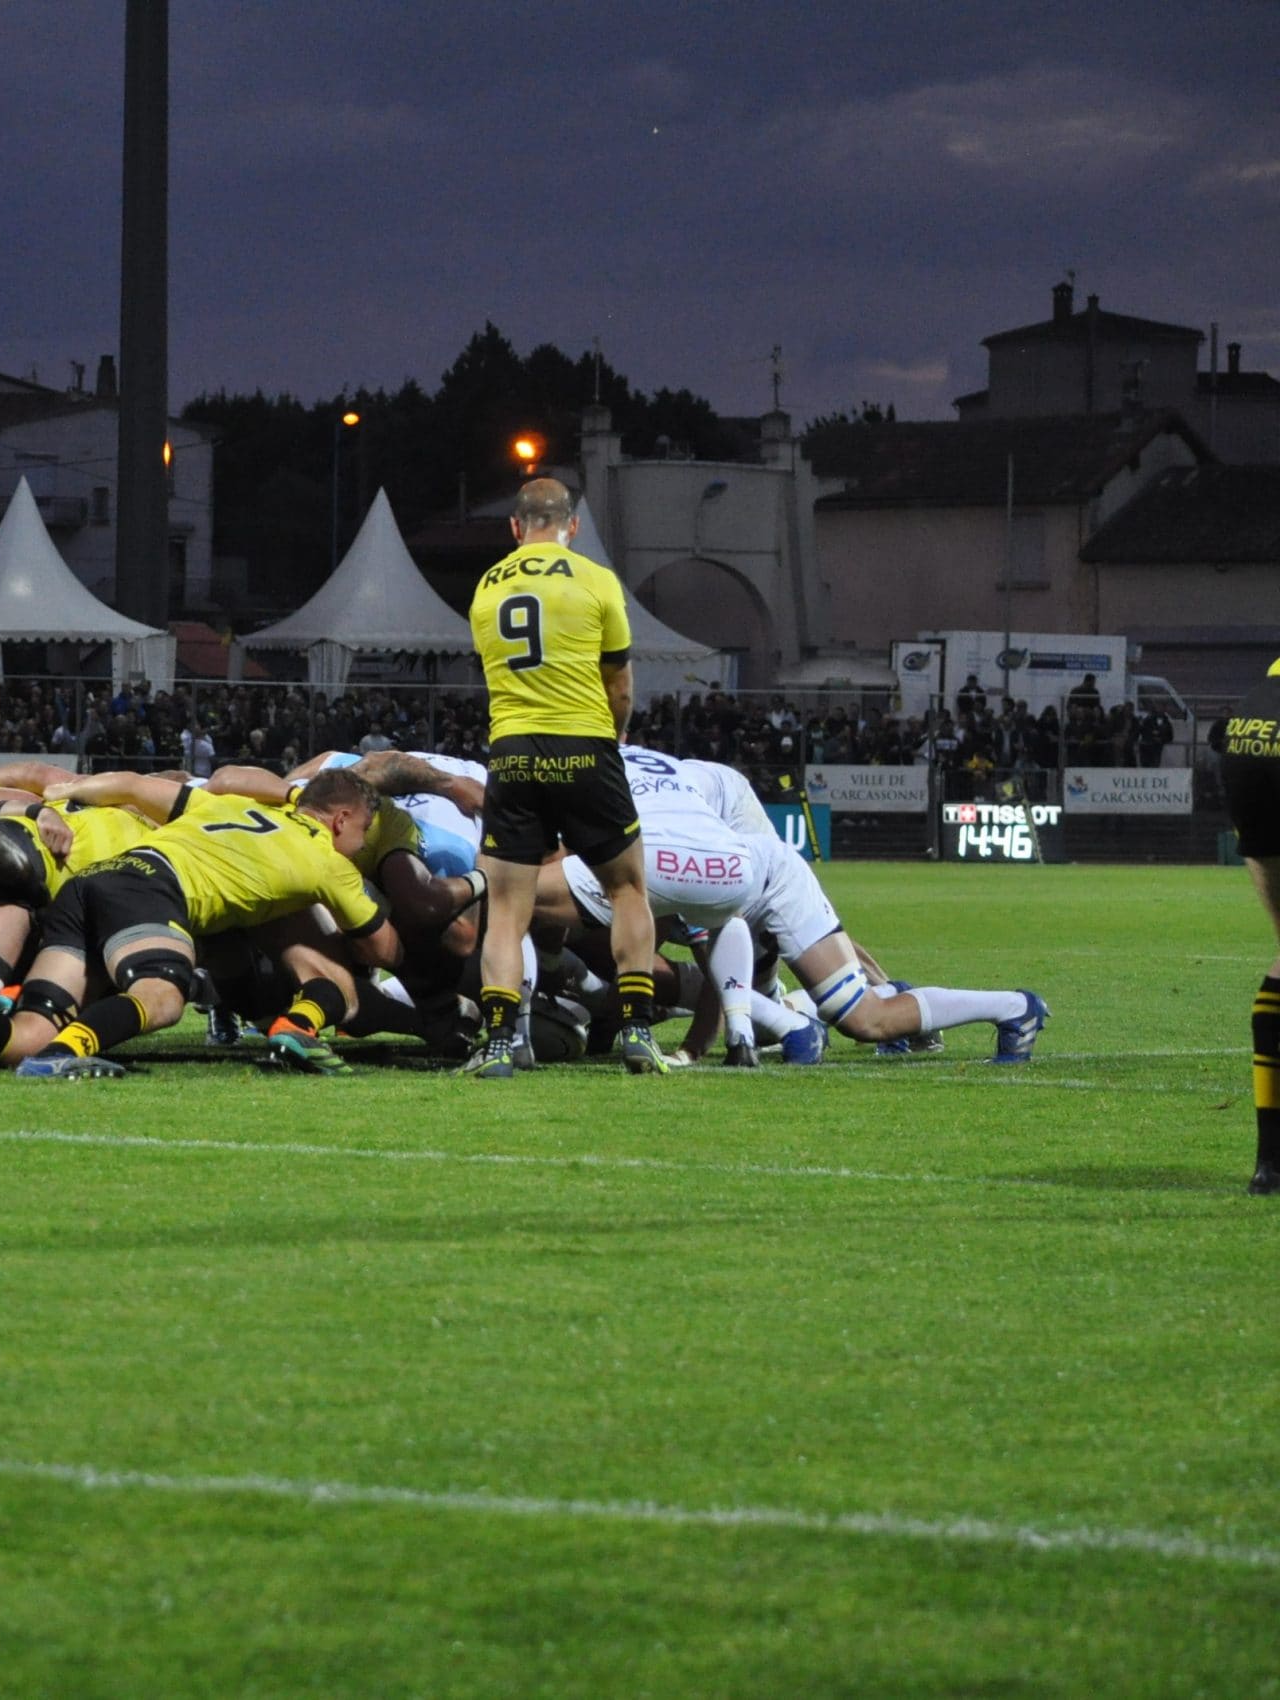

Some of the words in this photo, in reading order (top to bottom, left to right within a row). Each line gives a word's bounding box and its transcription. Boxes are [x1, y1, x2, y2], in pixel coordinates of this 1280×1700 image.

[483, 557, 574, 590] RECA
[497, 592, 544, 672] 9
[534, 754, 596, 770] MAURIN
[850, 774, 884, 786] VILLE
[889, 774, 906, 786] DE
[1112, 777, 1147, 789] VILLE
[1152, 777, 1169, 789] DE
[830, 789, 928, 801] CARCASSONNE
[1091, 791, 1191, 804] CARCASSONNE
[202, 810, 280, 834] 7
[976, 804, 1062, 825] TISSOT
[958, 824, 1032, 859] 14:46
[656, 850, 743, 879] BAB2
